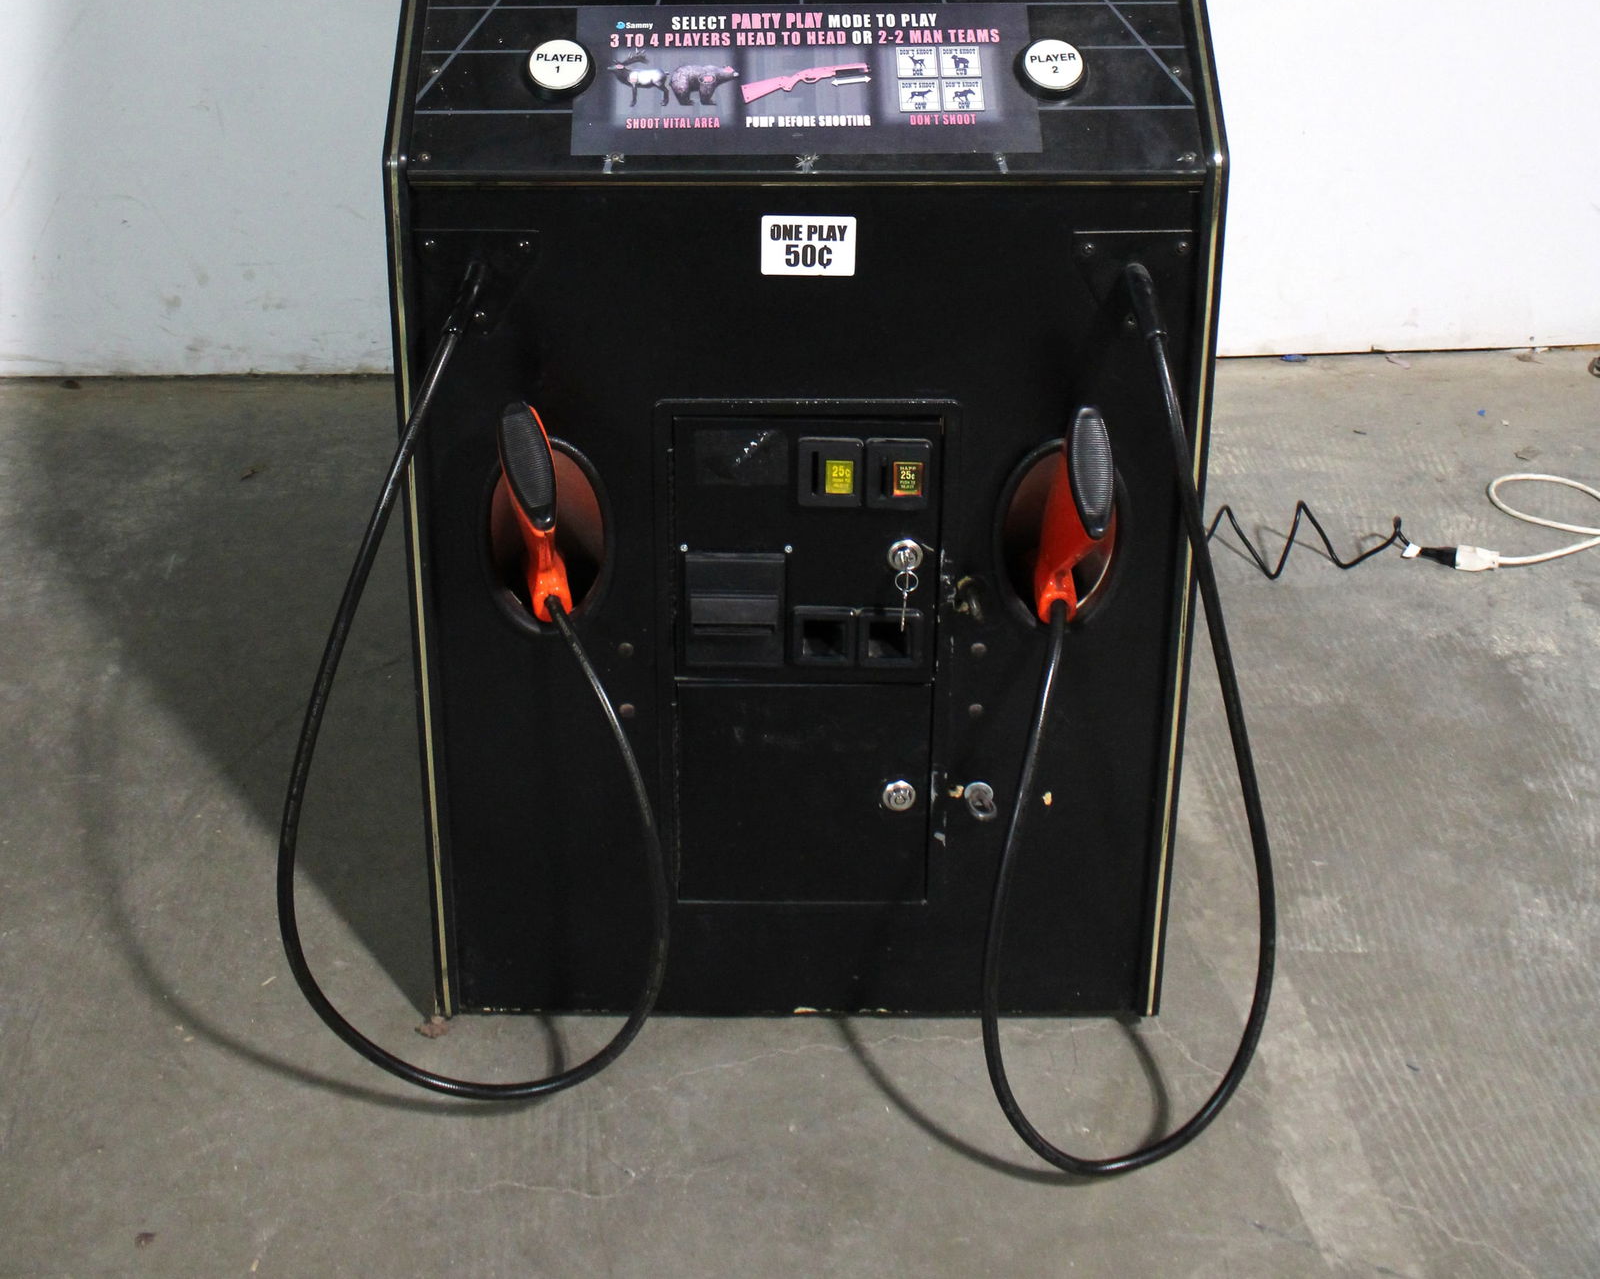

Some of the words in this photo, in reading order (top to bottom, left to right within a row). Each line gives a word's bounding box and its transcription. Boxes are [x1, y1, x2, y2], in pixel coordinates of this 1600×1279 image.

[626, 21, 654, 30] Sammy
[671, 16, 727, 30] SELECT
[731, 13, 781, 29] PARTY
[786, 13, 823, 29] PLAY
[828, 14, 871, 29] MODE
[876, 14, 895, 28] TO
[901, 13, 937, 27] PLAY
[609, 33, 620, 48] 3
[625, 33, 645, 48] TO
[649, 33, 659, 47] 4
[664, 32, 731, 47] PLAYERS
[736, 32, 776, 46] HEAD
[781, 31, 801, 46] TO
[806, 31, 846, 45] HEAD
[852, 30, 873, 45] OR
[878, 30, 904, 44] 2-2
[909, 29, 943, 44] MAN
[948, 28, 1000, 43] TEAMS
[536, 53, 583, 63] PLAYER
[1030, 52, 1077, 63] PLAYER
[554, 65, 561, 74] 1
[1051, 65, 1059, 74] 2
[626, 118, 659, 129] SHOOT
[663, 118, 691, 129] VITAL
[694, 117, 720, 129] AREA
[745, 116, 775, 128] PUMP
[778, 116, 816, 128] BEFORE
[818, 114, 871, 127] SHOOTING
[910, 114, 939, 125] DON'T
[942, 114, 976, 125] SHOOT
[770, 224, 803, 241] ONE
[807, 224, 848, 241] PLAY
[785, 244, 832, 269] 50¢
